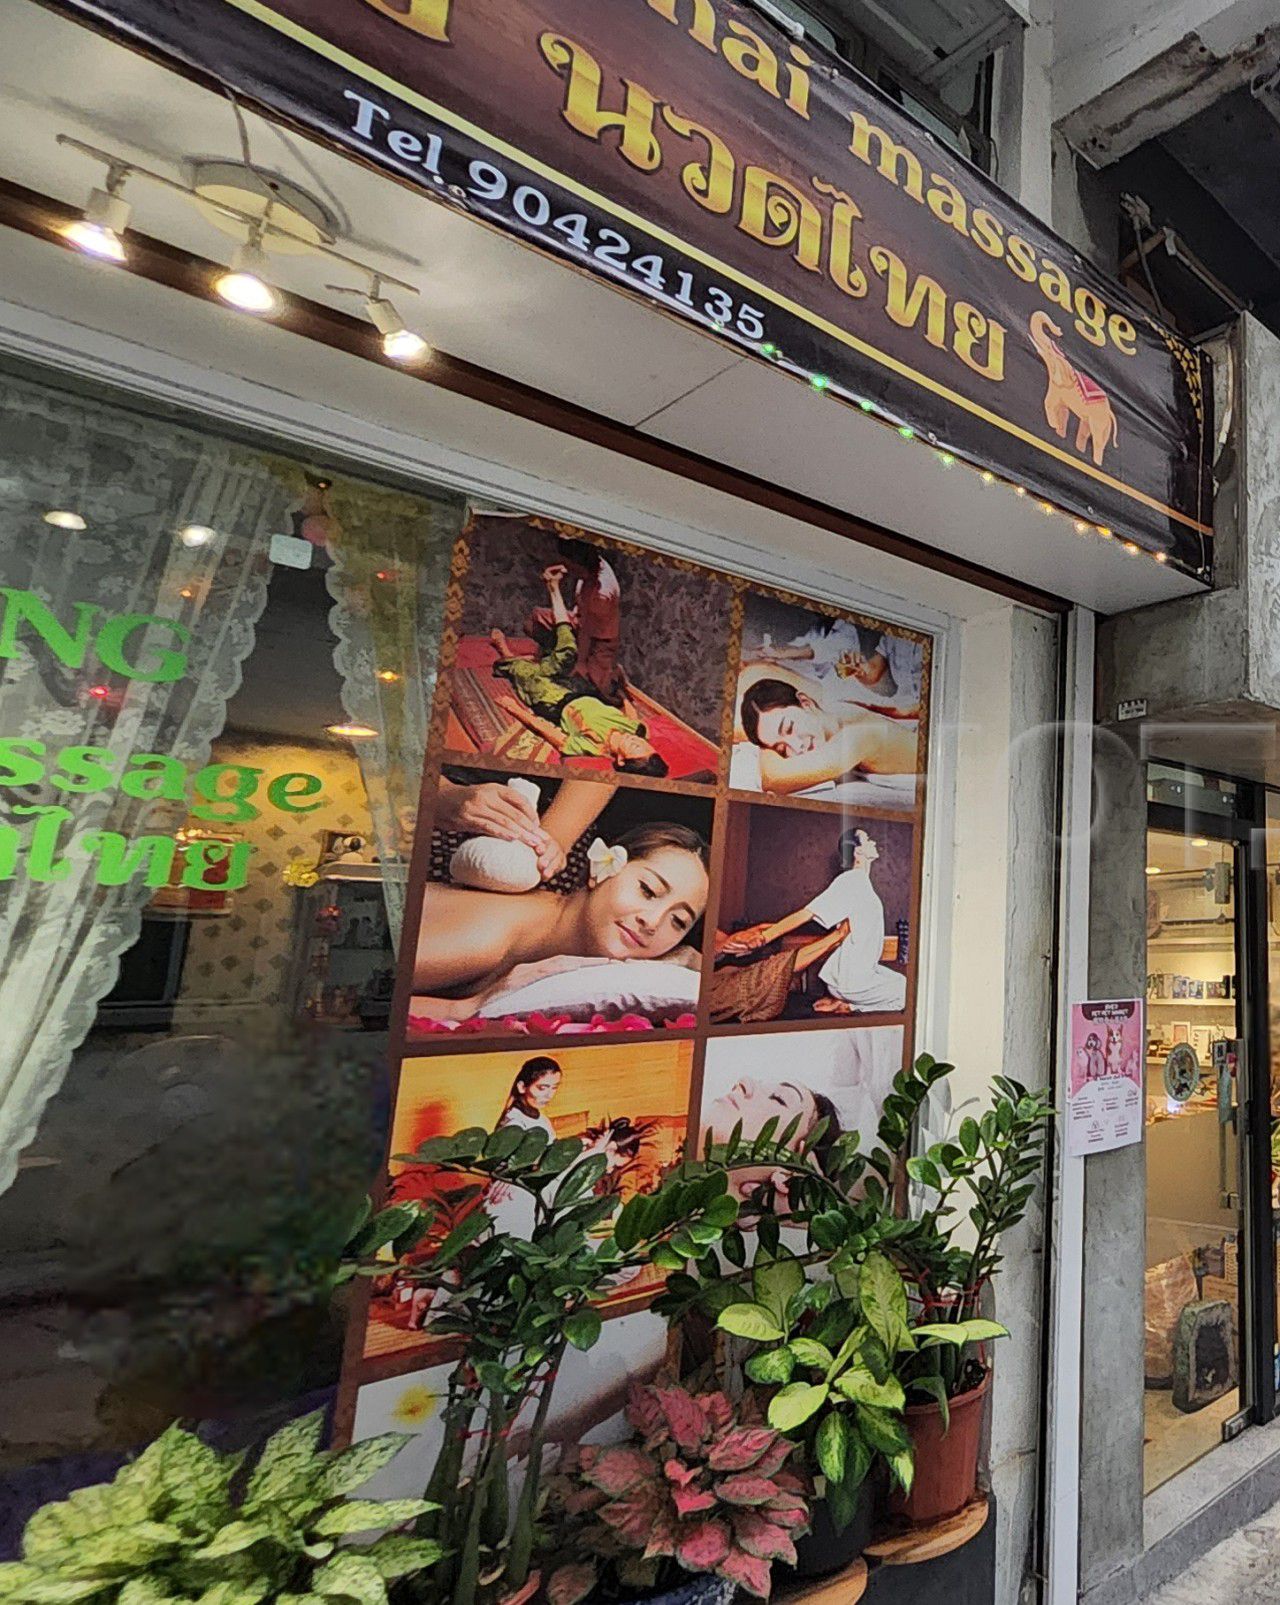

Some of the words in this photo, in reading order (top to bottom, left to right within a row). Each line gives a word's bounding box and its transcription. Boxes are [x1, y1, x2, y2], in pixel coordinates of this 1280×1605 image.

[467, 159, 767, 341] 90424135
[540, 30, 1009, 384] นวดไทย
[848, 111, 1140, 358] massage
